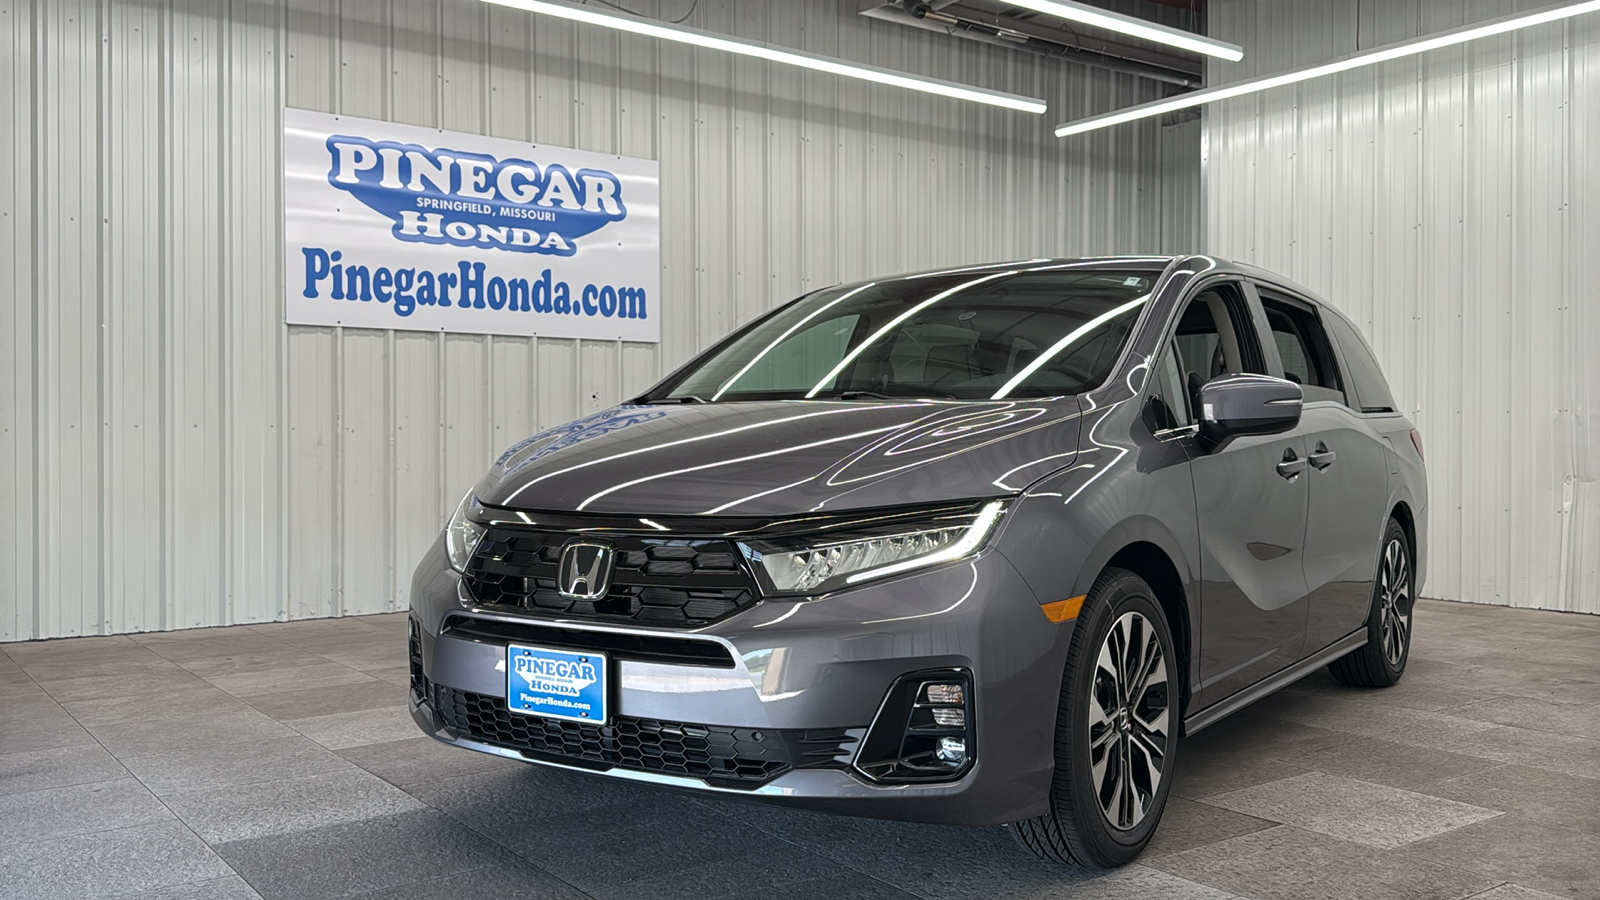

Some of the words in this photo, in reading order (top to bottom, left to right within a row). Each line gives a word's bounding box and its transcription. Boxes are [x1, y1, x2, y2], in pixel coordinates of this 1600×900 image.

[334, 142, 622, 216] PINEGAR
[416, 196, 497, 218] SPRINGFIELD,
[499, 206, 556, 223] MISSOURI
[399, 210, 572, 251] HONDA
[302, 247, 648, 319] PinegarHonda.com
[516, 657, 595, 681] PINEGAR
[530, 679, 579, 696] HONDA
[520, 692, 591, 711] PinegarHonda.com
